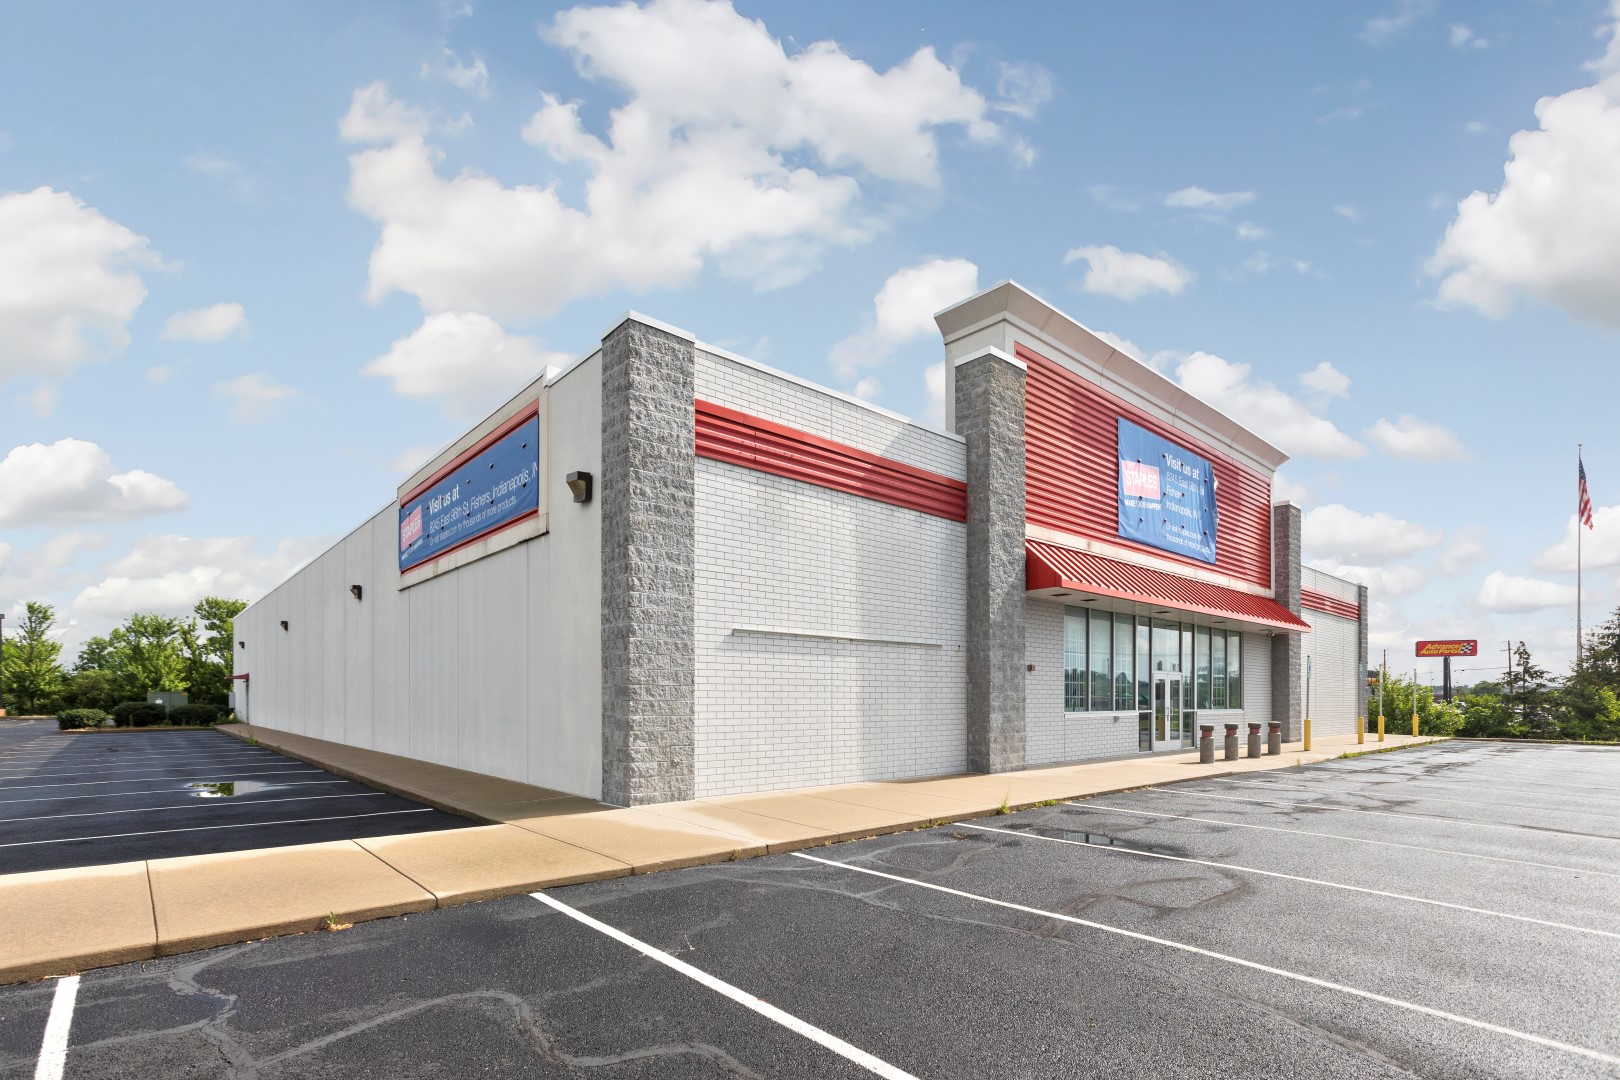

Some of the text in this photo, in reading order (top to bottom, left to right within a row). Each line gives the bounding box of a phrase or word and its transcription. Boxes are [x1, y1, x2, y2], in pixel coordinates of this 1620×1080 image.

[1125, 471, 1158, 489] STAPLES
[1166, 453, 1200, 480] Visit us at
[1179, 476, 1189, 489] East
[429, 484, 460, 515] Visit us at
[441, 512, 451, 527] East
[492, 468, 531, 500] Indianapolis,
[401, 514, 421, 543] STAPLES
